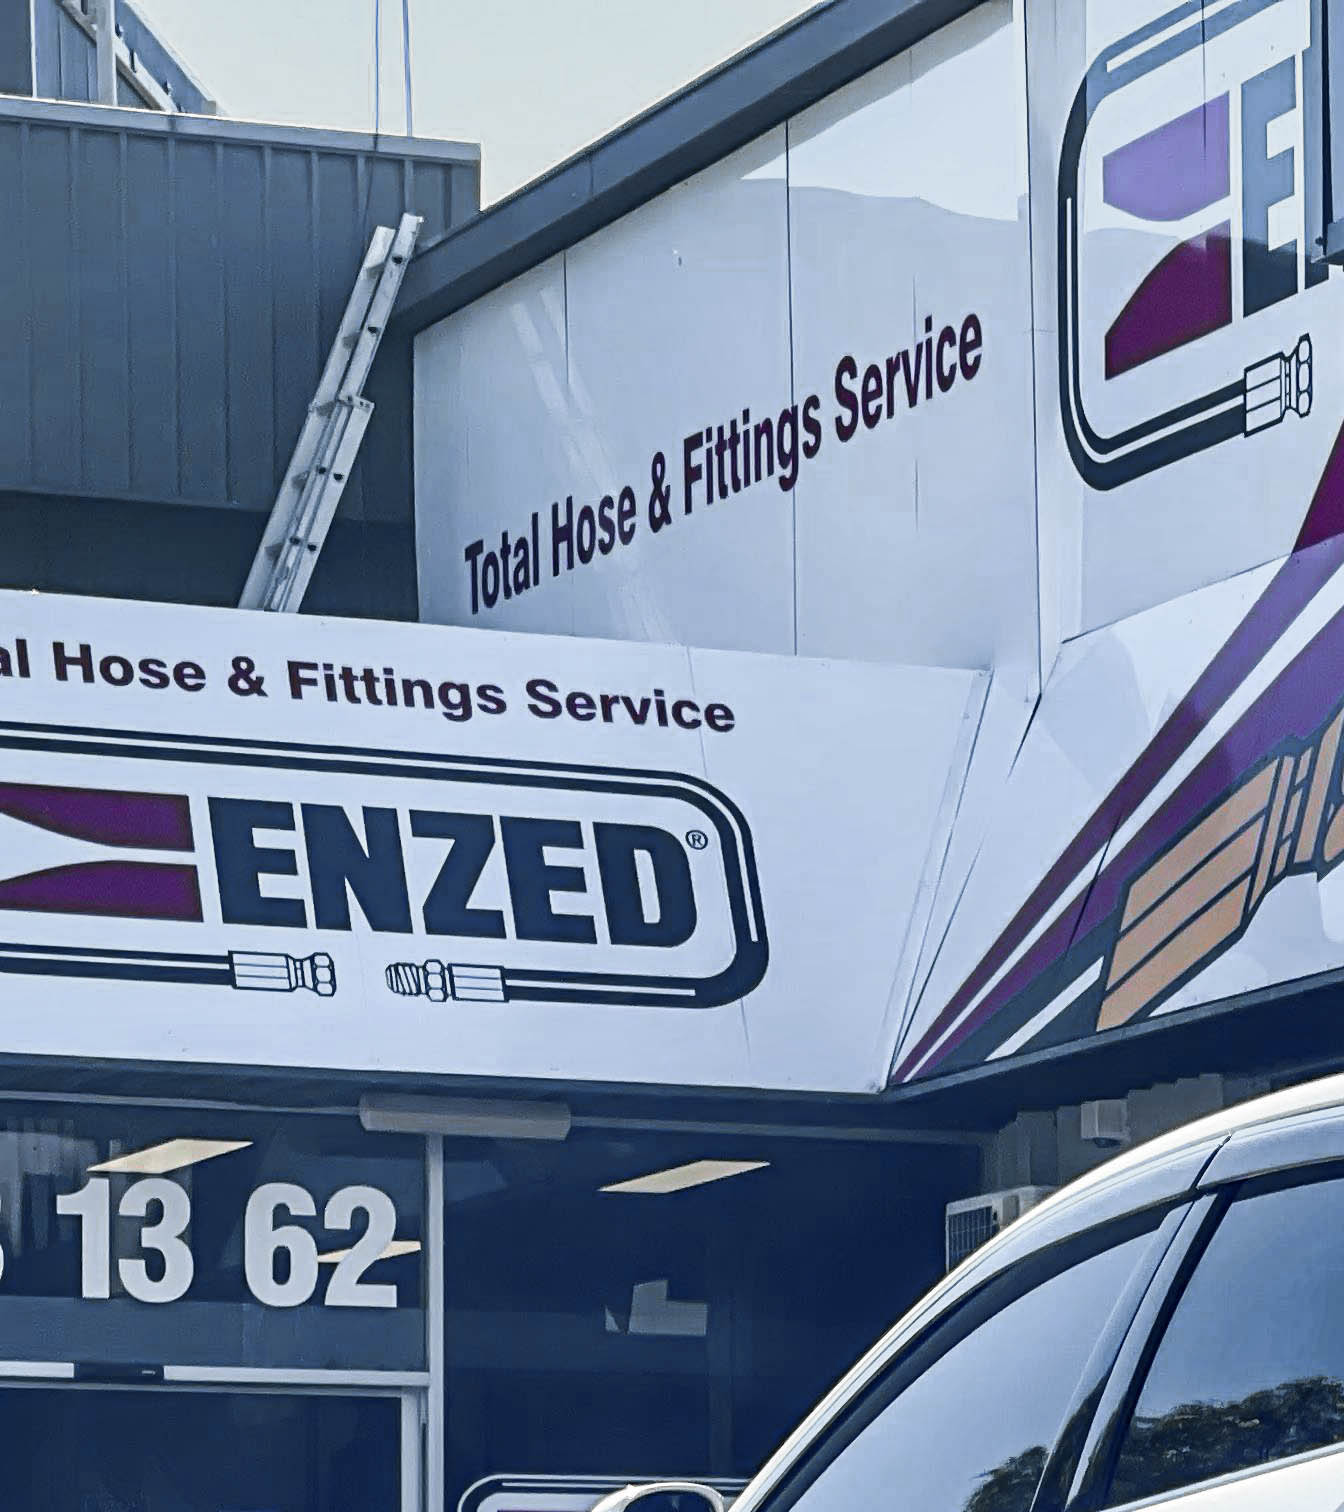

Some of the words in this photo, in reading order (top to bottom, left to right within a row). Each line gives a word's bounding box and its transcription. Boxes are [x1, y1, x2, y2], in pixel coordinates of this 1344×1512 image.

[464, 513, 541, 615] Total
[551, 484, 637, 574] Hose
[648, 452, 671, 532] &
[683, 396, 822, 516] Fittings
[834, 312, 984, 444] Service
[53, 641, 206, 691] Hose
[229, 656, 267, 696] &
[288, 661, 507, 722] Fittings
[527, 679, 737, 733] Service
[56, 1178, 194, 1303] 13
[245, 1183, 398, 1308] 62
